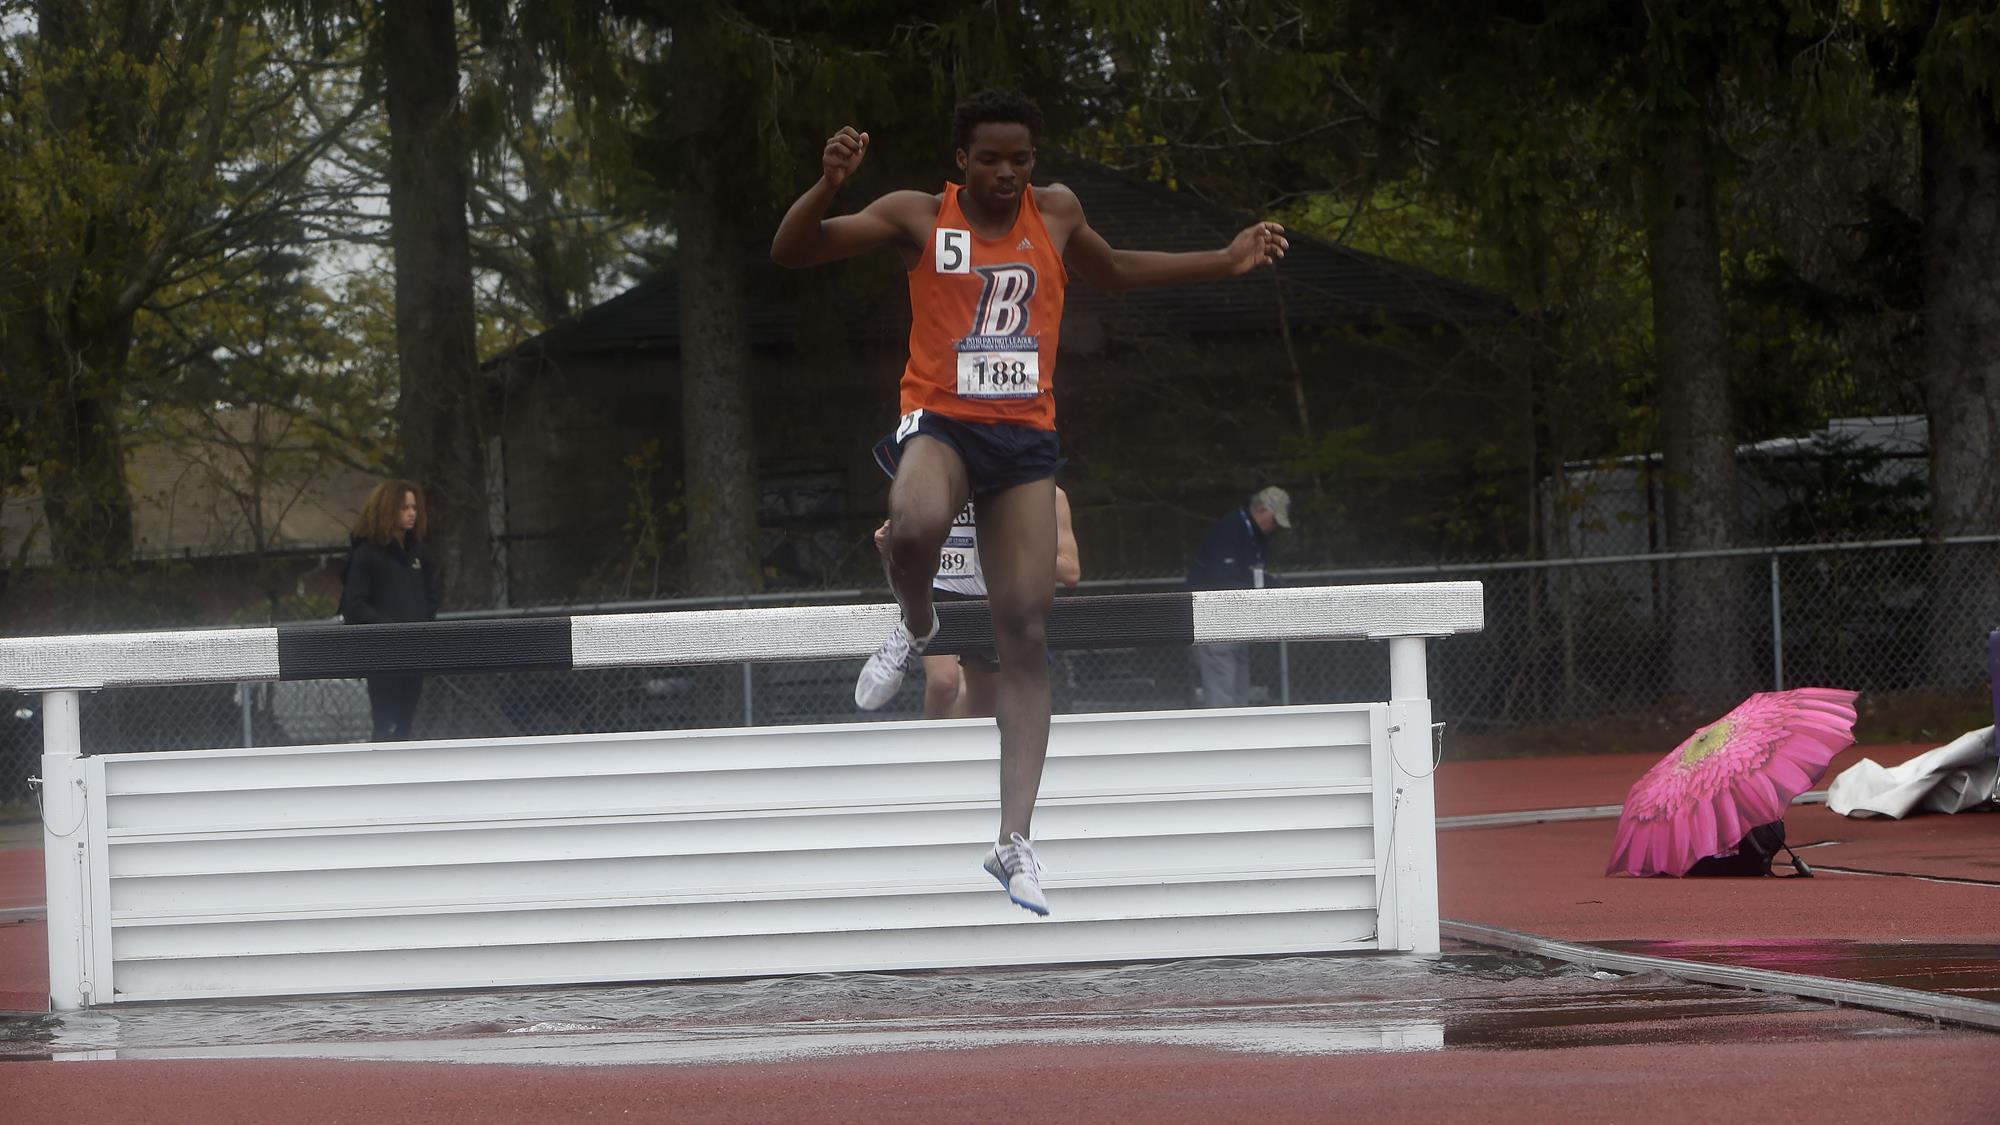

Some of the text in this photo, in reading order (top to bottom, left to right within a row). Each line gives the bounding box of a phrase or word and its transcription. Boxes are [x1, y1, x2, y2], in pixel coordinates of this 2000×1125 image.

[944, 232, 963, 270] 5
[970, 263, 1038, 337] B
[974, 361, 1027, 385] 188
[942, 554, 965, 570] 89
